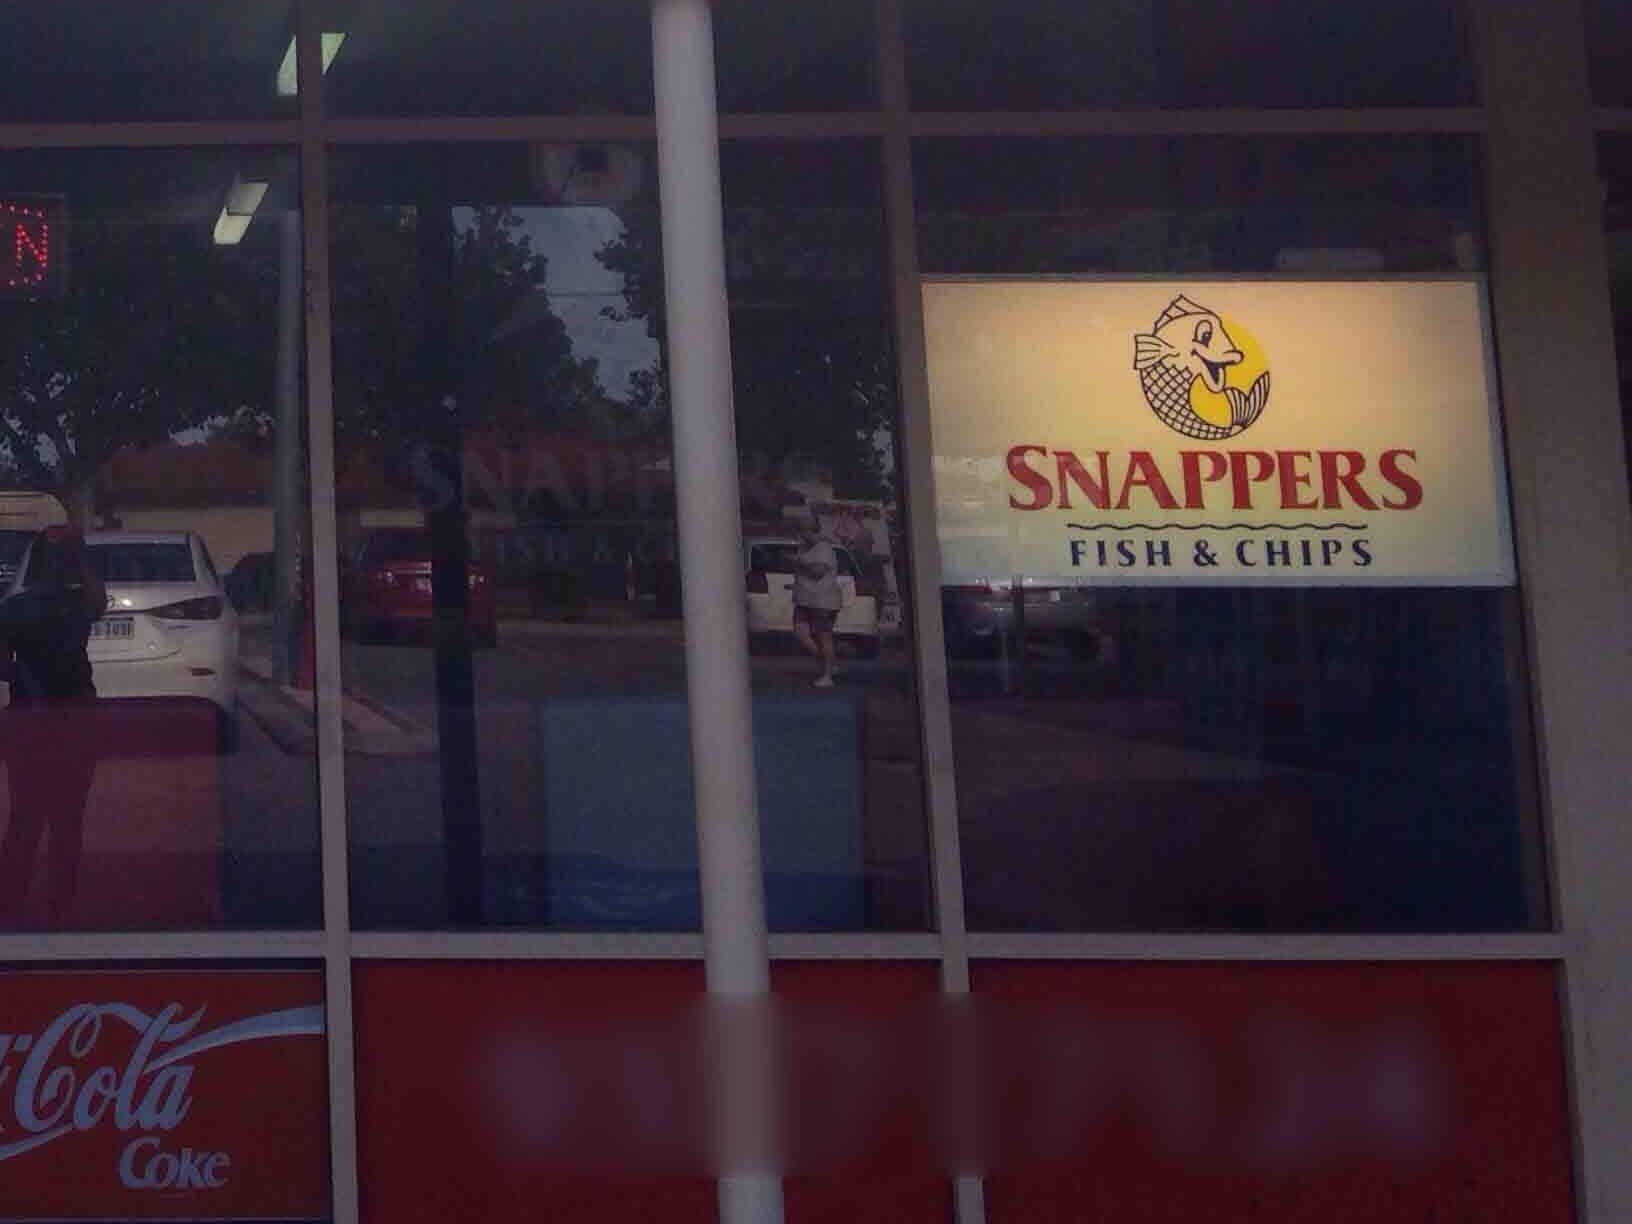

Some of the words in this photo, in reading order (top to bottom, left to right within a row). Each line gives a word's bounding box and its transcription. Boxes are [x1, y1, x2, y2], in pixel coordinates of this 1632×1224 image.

[1005, 445, 1424, 512] SNAPPERS
[1070, 538, 1172, 567] FISH
[1192, 538, 1220, 567] &
[1235, 538, 1373, 568] CHIPS
[118, 1136, 232, 1191] Coke
